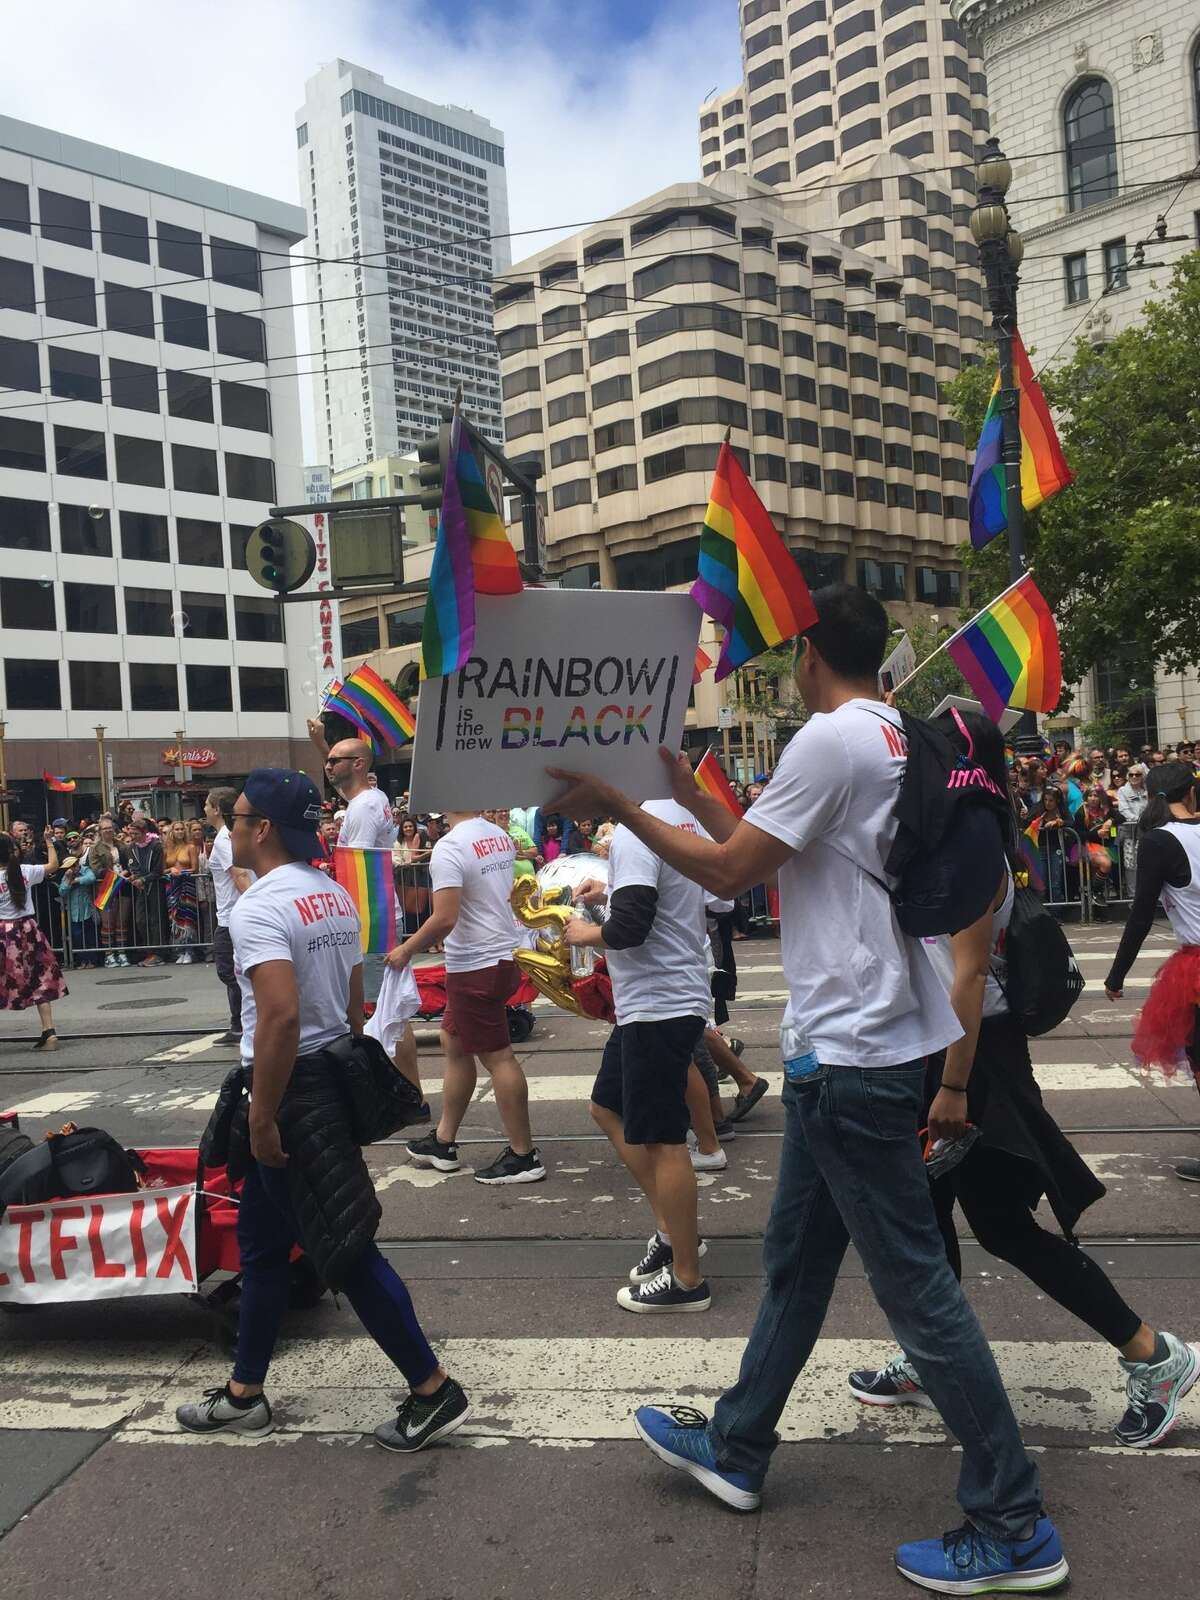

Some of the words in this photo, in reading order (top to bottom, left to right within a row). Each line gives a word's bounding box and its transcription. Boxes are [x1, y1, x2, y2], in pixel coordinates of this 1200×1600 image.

[314, 512, 328, 572] RITZ
[318, 580, 335, 669] CAMERA
[457, 656, 666, 699] RAINBOW
[456, 721, 484, 736] the
[458, 705, 473, 721] is
[501, 704, 653, 749] BLACK
[455, 736, 493, 750] new
[472, 834, 513, 860] NETFLIX
[0, 1193, 194, 1286] TFLIX
